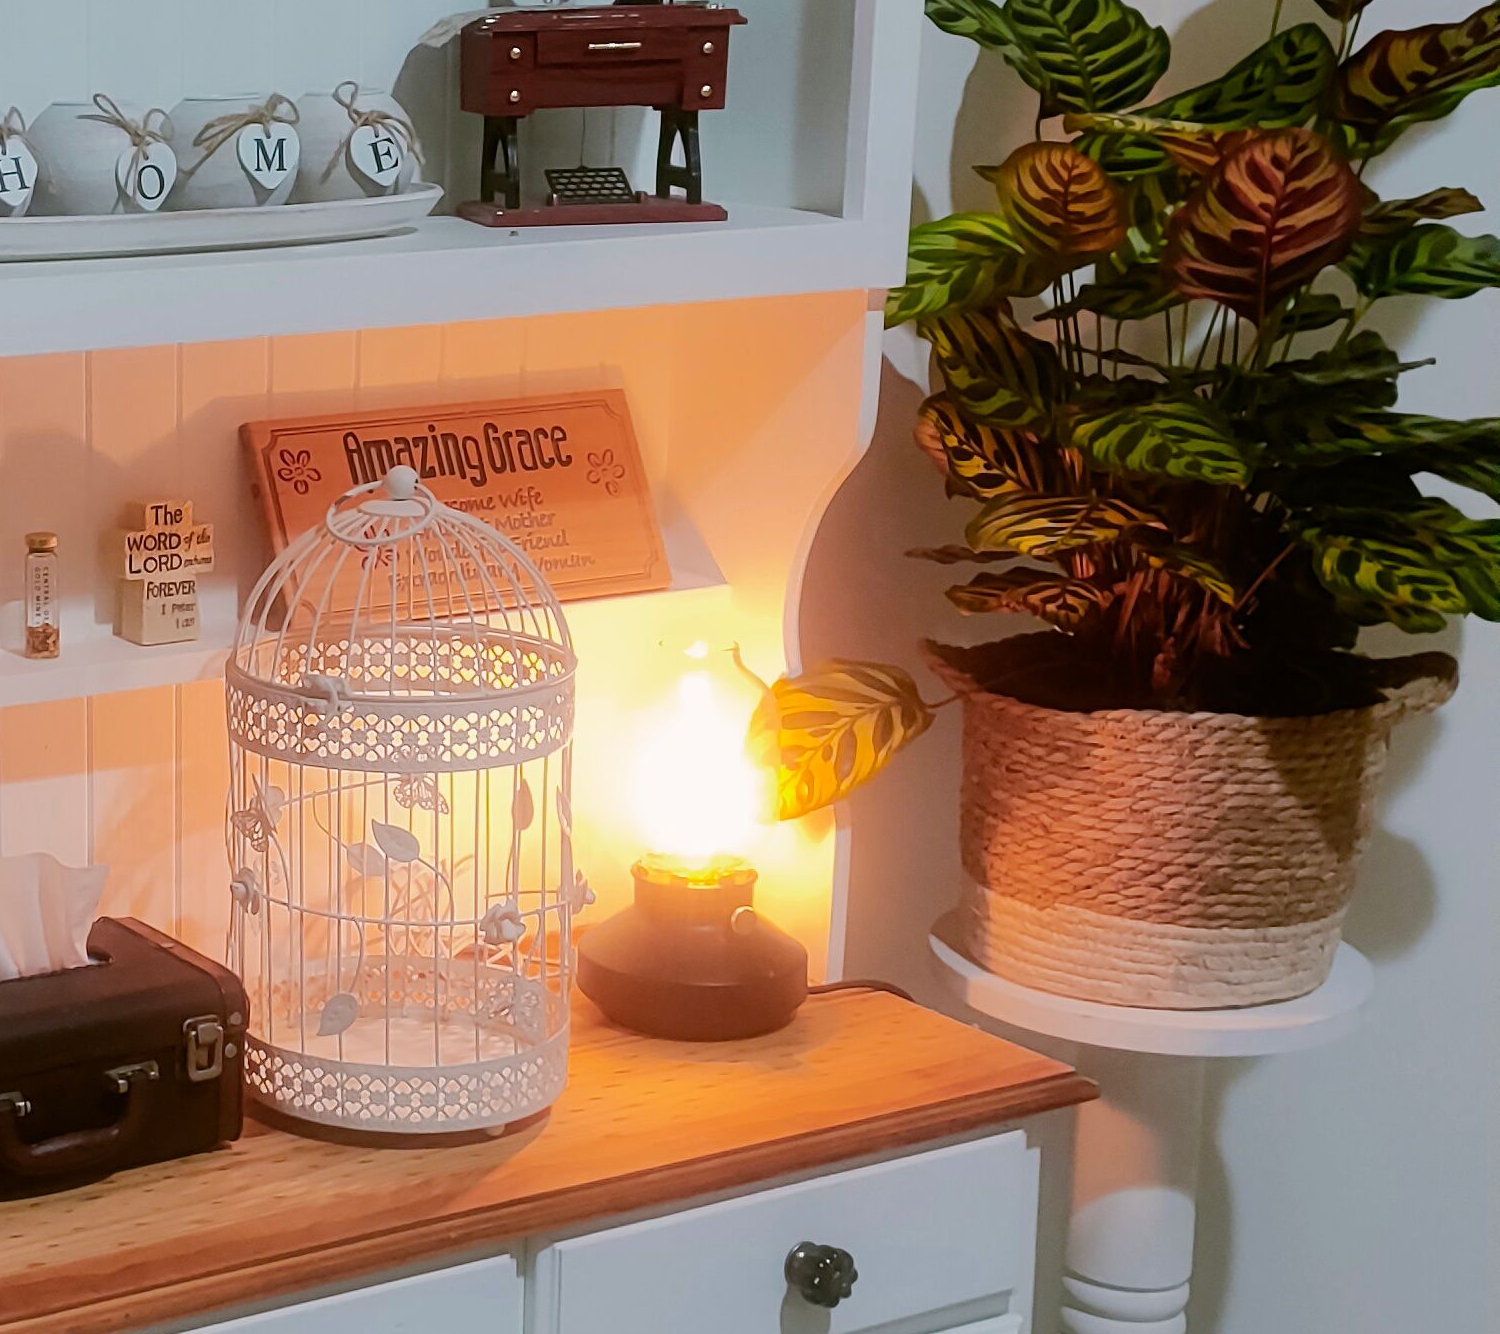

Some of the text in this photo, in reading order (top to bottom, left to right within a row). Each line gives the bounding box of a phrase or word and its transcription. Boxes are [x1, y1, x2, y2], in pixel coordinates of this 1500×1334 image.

[342, 422, 573, 493] Amazing Grace
[499, 486, 544, 512] Wife
[150, 504, 183, 526] The
[494, 510, 556, 532] Mother
[127, 532, 181, 552] WORD
[128, 553, 182, 574] LORD
[146, 580, 196, 600] FOREVER
